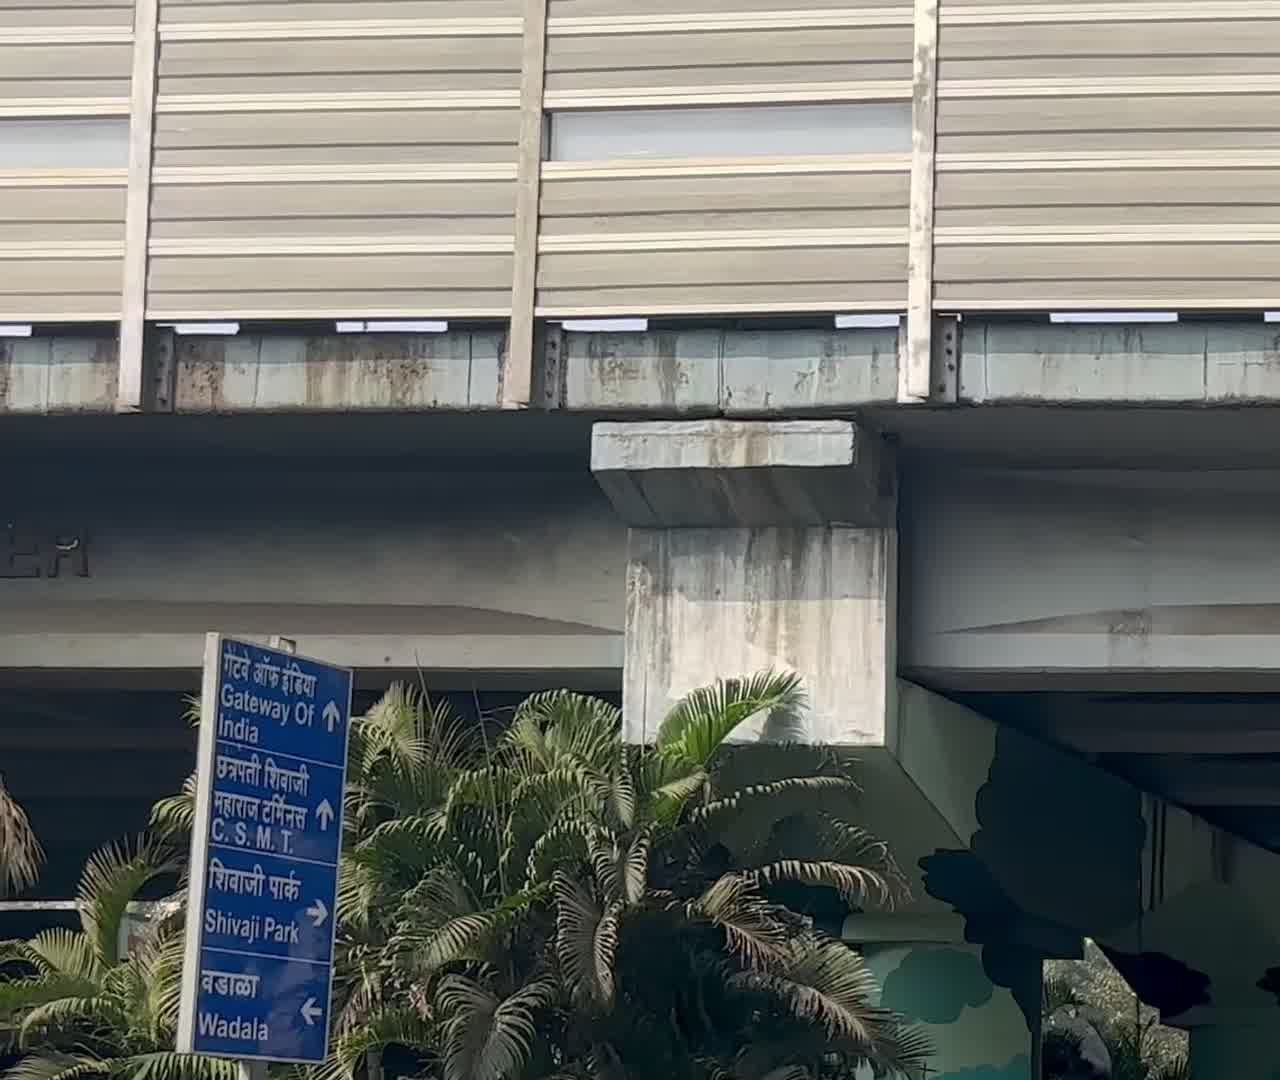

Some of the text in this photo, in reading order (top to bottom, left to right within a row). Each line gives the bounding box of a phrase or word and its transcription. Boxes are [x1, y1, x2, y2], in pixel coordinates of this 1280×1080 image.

[253, 655, 281, 689] ऑफ
[281, 661, 318, 698] इंडिया
[221, 684, 315, 727] Gateway Of
[219, 713, 259, 745] India
[216, 753, 310, 797] छत्रपती शिवाजी
[214, 790, 261, 820] महाराज
[209, 857, 302, 902] शिवाजी पार्क
[205, 908, 299, 944] Shivaji Park
[201, 969, 261, 998] वडाळा
[199, 1012, 269, 1041] Wadala
